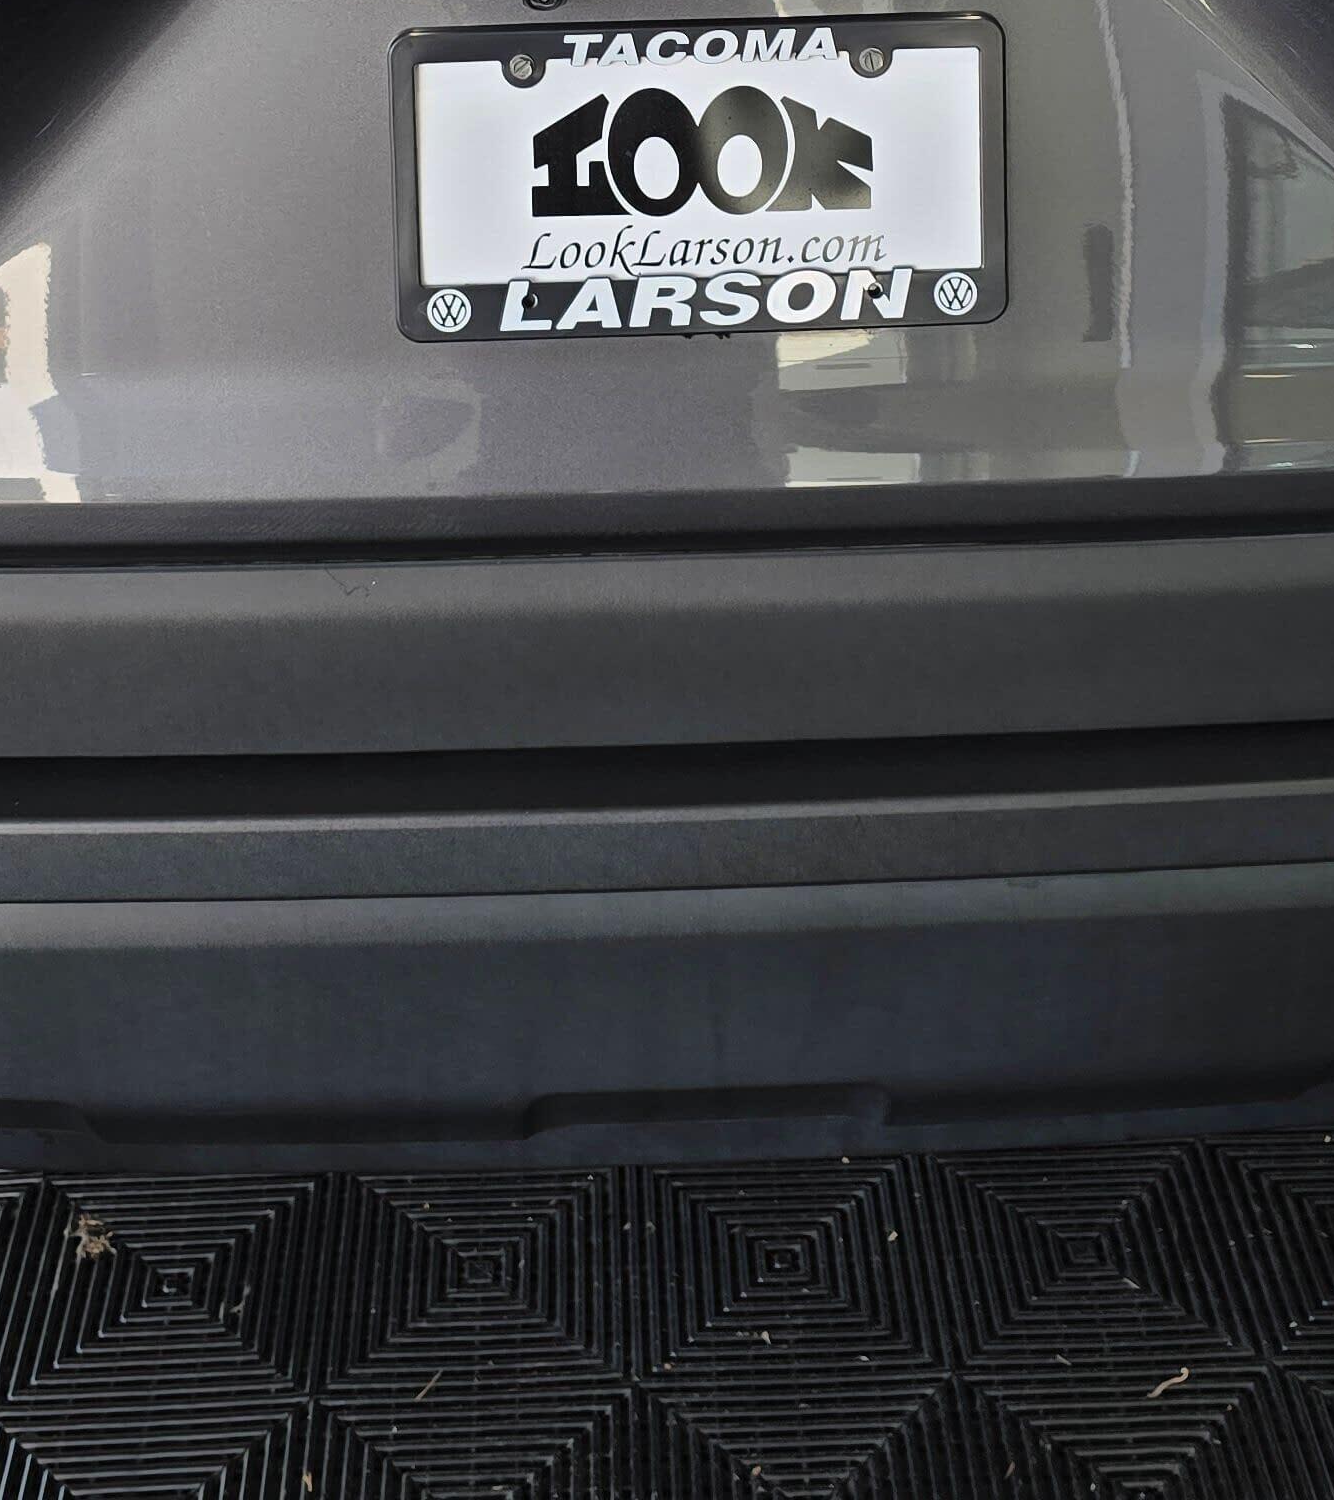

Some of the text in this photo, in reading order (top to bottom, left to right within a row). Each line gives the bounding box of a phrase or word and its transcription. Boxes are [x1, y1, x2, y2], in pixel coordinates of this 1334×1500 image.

[563, 26, 839, 67] TACOMA
[531, 85, 874, 218] LOOK
[521, 224, 888, 277] LookLarson.com
[499, 267, 916, 332] LARSON
